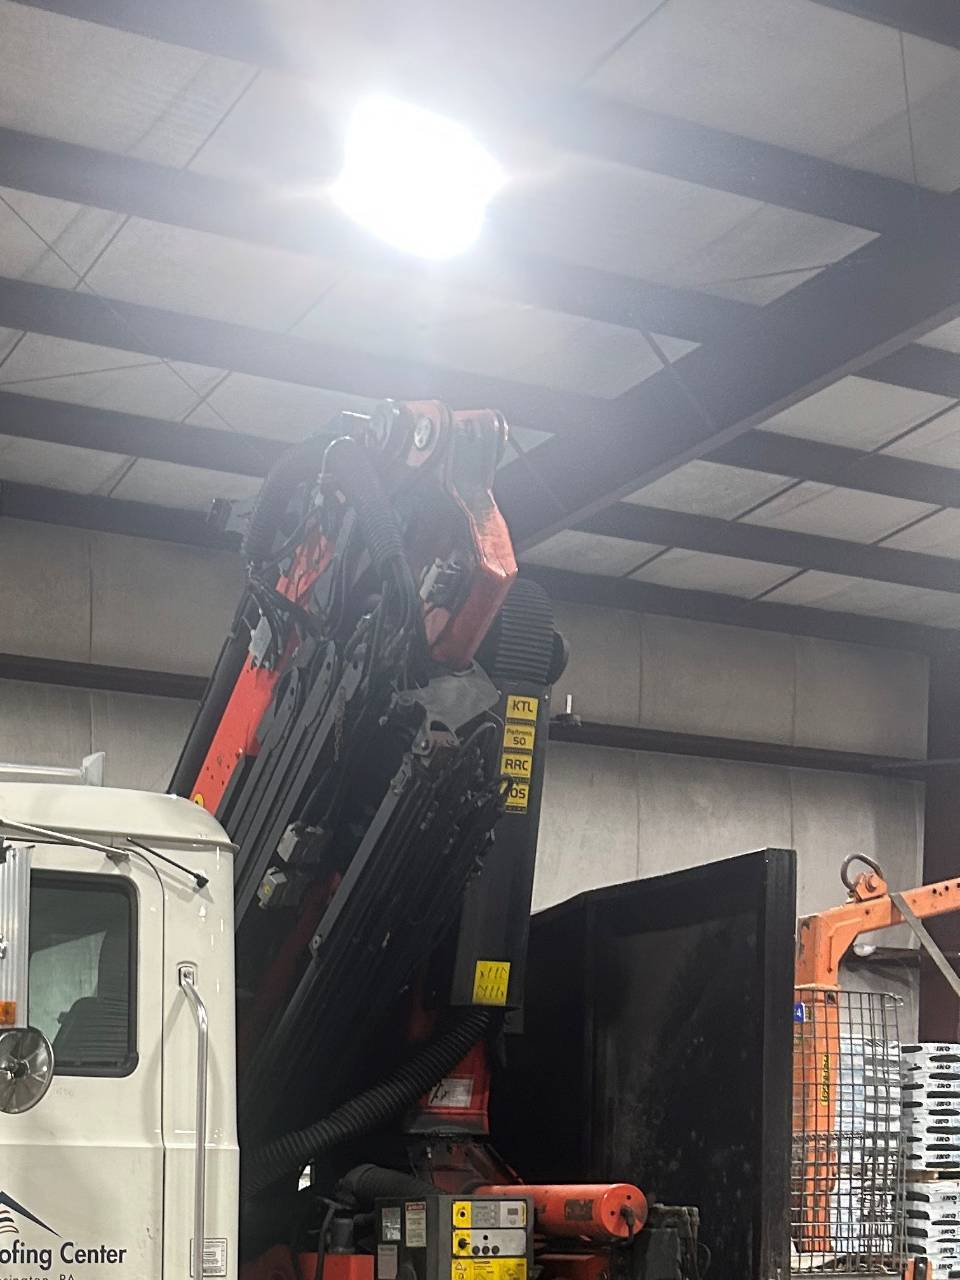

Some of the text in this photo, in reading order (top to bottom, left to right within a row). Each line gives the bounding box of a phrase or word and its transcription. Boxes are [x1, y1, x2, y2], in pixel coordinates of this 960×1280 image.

[511, 700, 534, 713] KTL
[504, 758, 529, 771] RRC
[60, 1242, 127, 1264] Center
